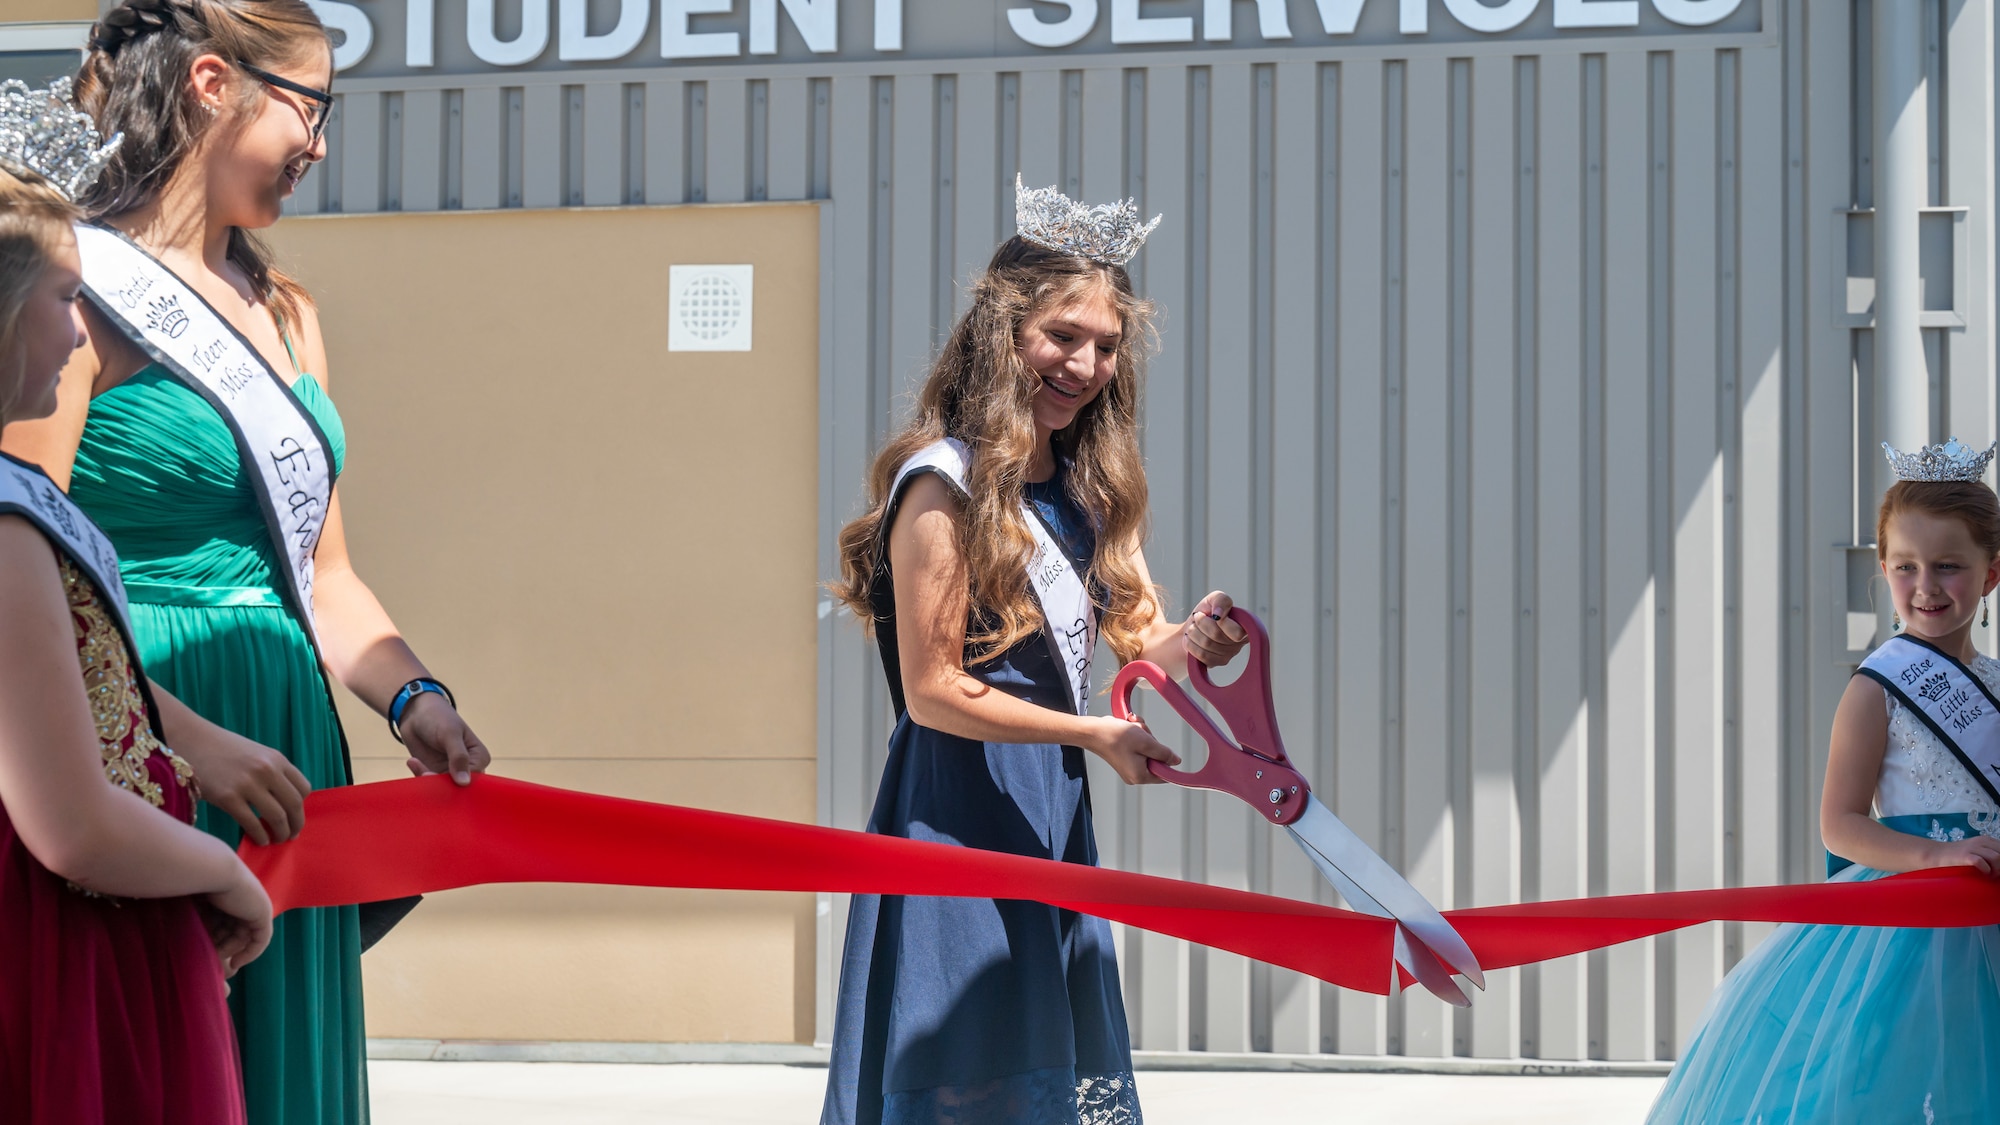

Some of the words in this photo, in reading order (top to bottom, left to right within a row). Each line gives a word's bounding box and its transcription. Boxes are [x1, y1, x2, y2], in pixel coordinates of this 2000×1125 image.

[192, 338, 228, 373] Teen
[220, 362, 254, 401] Miss
[1039, 560, 1064, 593] Miss
[1065, 618, 1091, 712] Edw
[1901, 658, 1934, 686] Elise
[1939, 688, 1970, 721] Little
[1952, 705, 1983, 734] Miss
